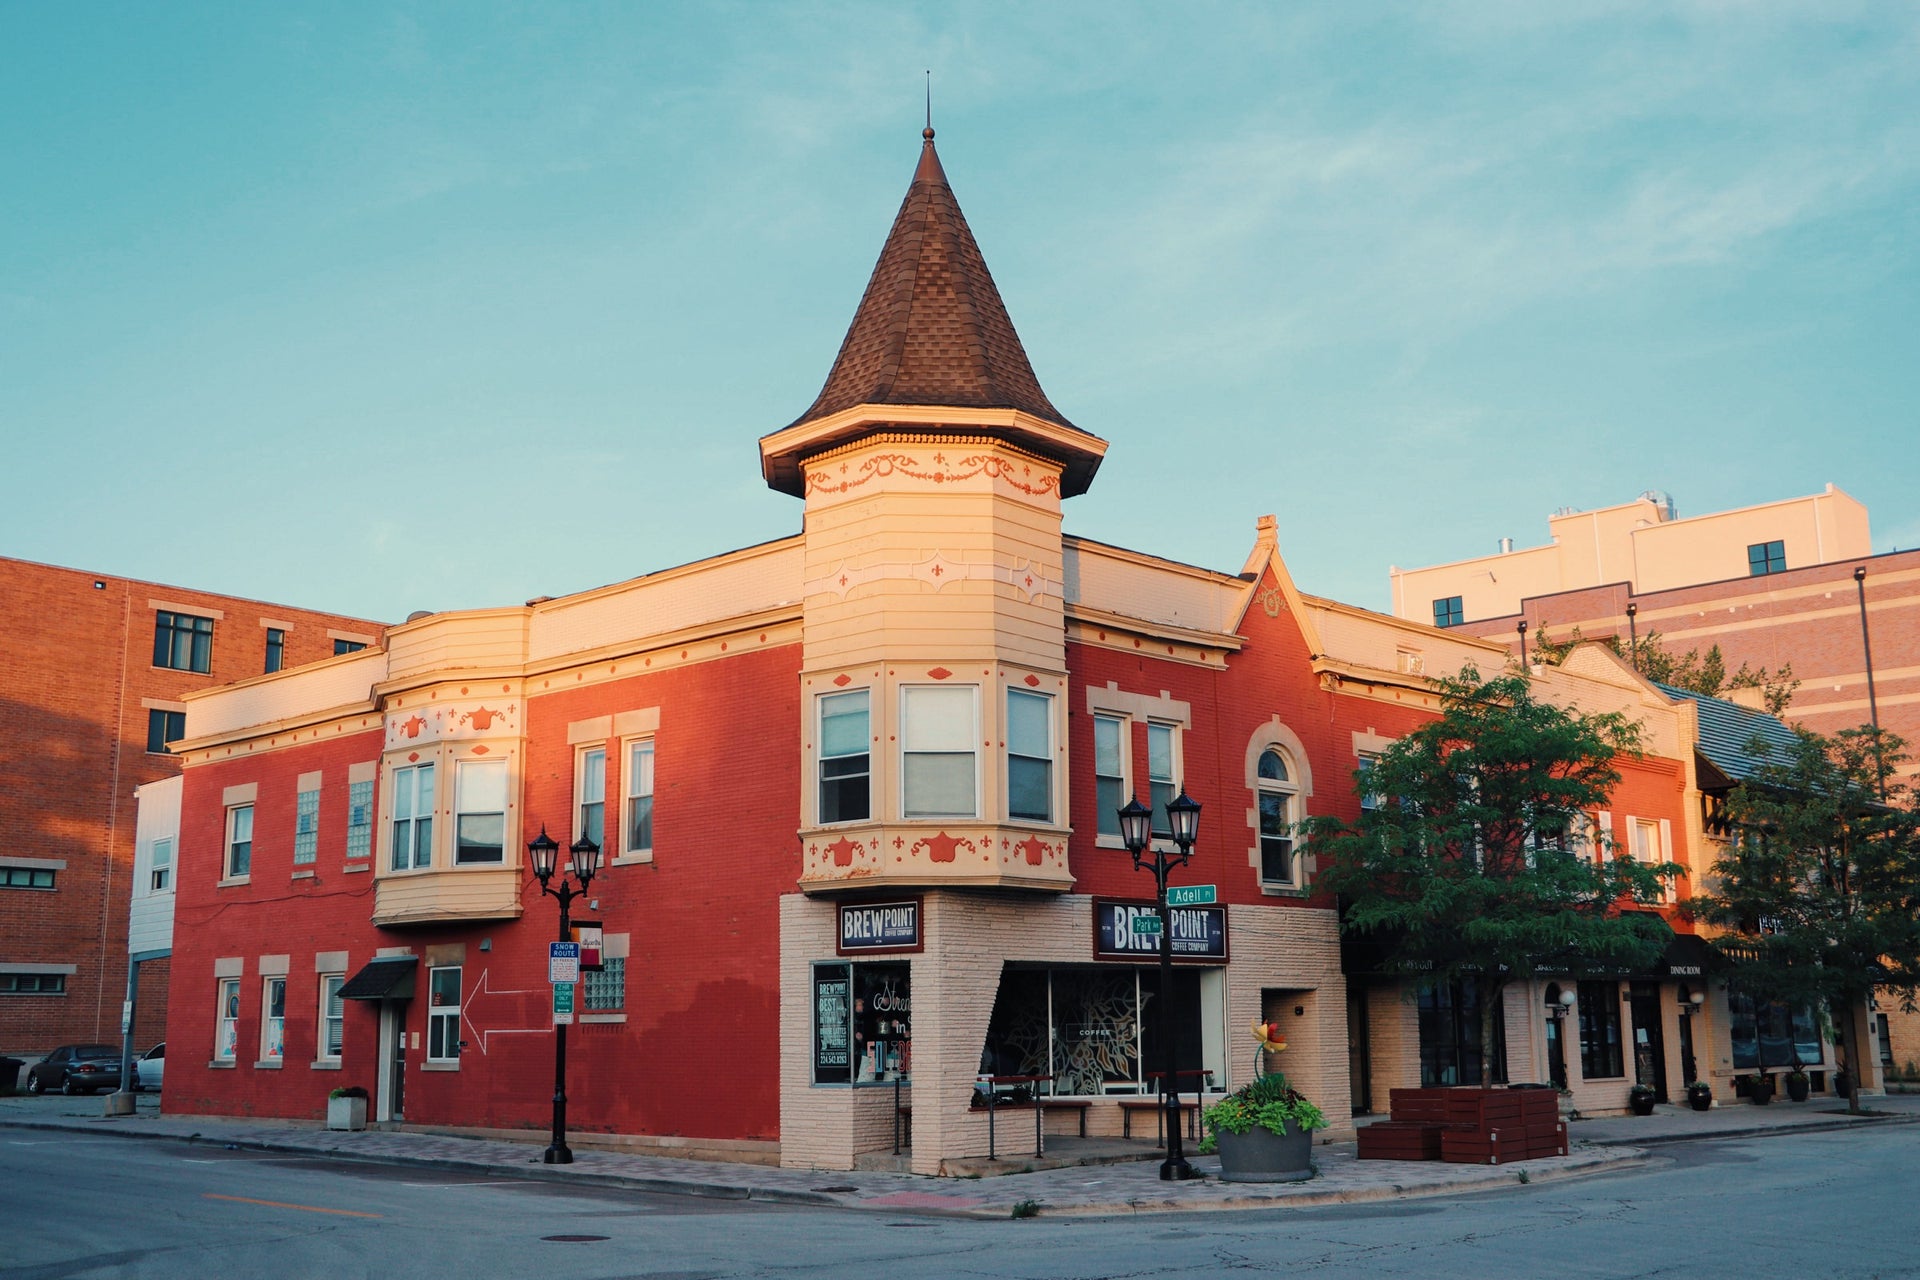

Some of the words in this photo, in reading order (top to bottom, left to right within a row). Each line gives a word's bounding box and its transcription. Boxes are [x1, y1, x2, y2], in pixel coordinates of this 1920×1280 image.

[1175, 889, 1200, 903] Adell
[1136, 918, 1151, 932] Park
[1170, 909, 1209, 938] POINT
[1171, 941, 1187, 952] COFFEE
[1187, 942, 1209, 952] COMPANY
[1670, 965, 1686, 975] DINING
[1686, 966, 1700, 975] ROOM
[819, 998, 836, 1012] BEST
[896, 1021, 906, 1034] in
